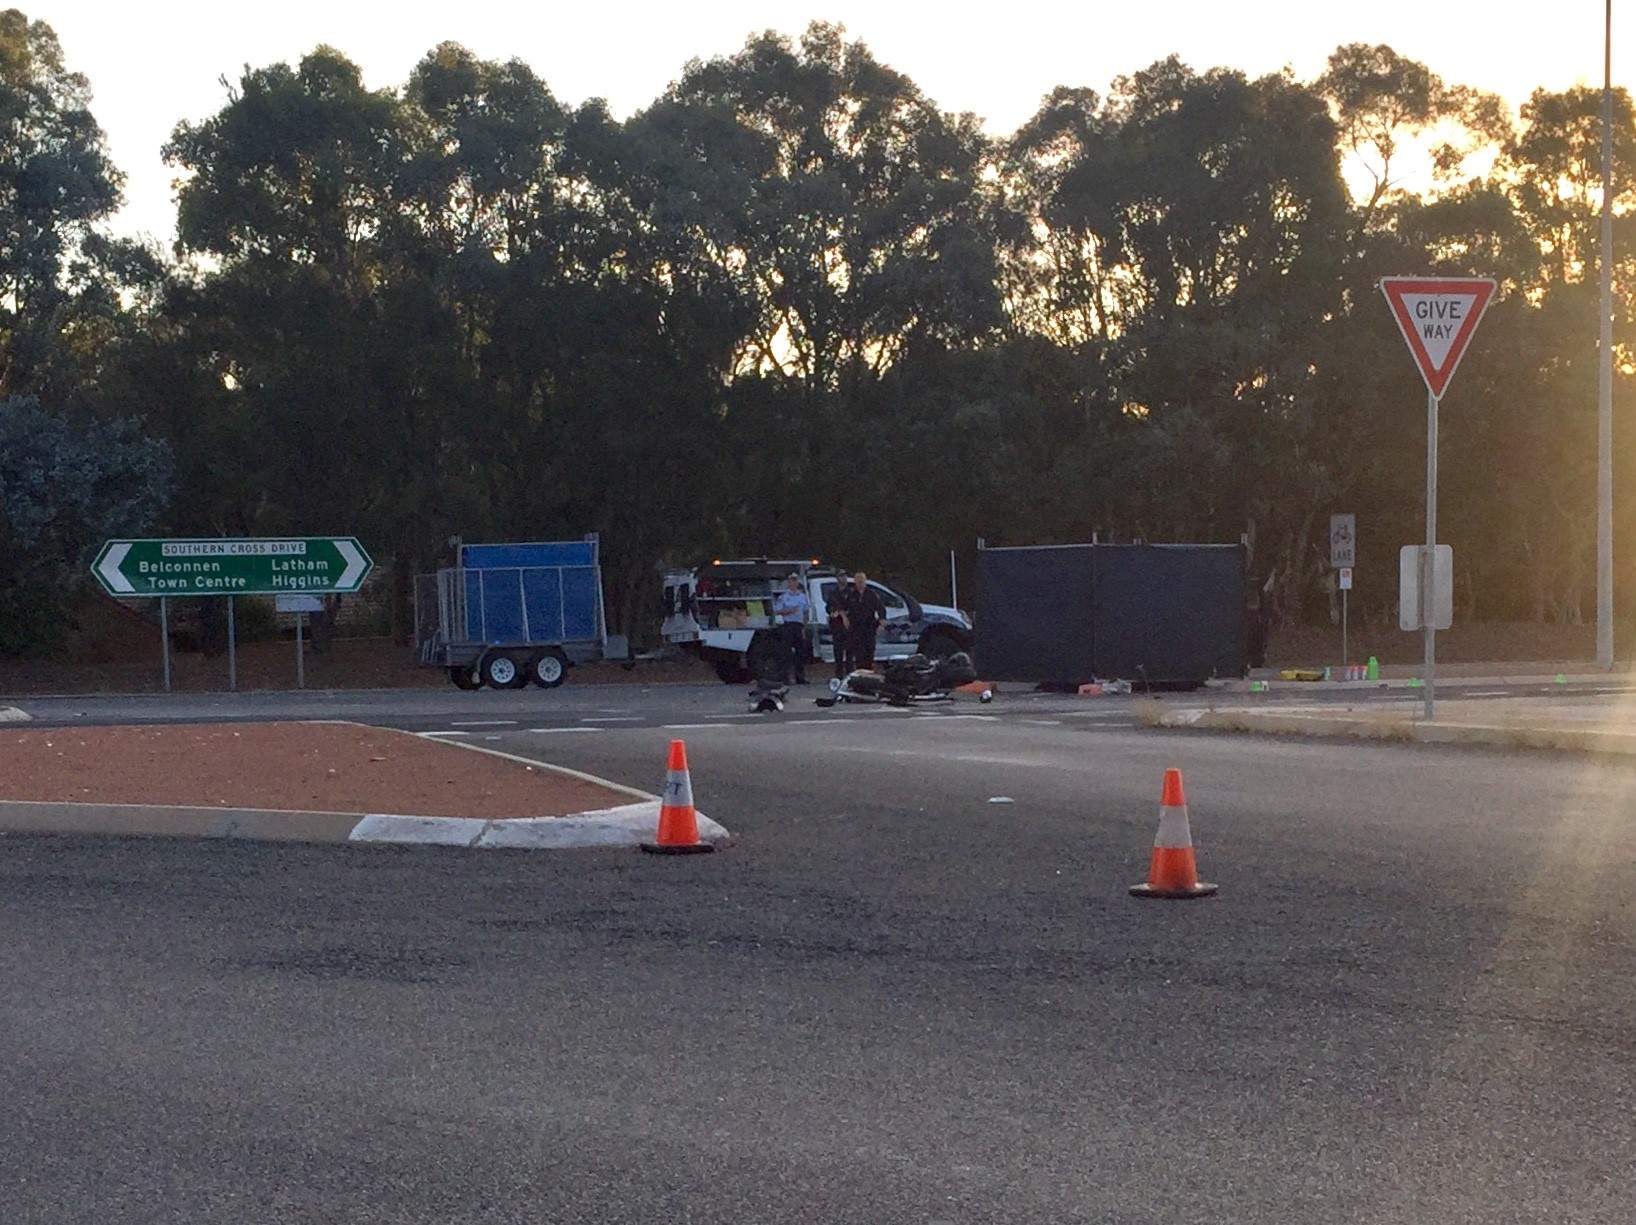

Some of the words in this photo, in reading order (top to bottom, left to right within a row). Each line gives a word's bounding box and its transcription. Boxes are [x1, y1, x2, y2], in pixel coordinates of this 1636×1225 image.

[1415, 301, 1461, 320] GIVE
[1423, 324, 1453, 339] WAY
[163, 544, 225, 555] SOUTHERN
[230, 543, 266, 554] CROSS
[271, 542, 305, 553] DRIVE
[139, 561, 221, 573] Belconnen
[271, 559, 329, 571] Latham
[148, 577, 188, 589] Town
[195, 576, 246, 588] Centre
[271, 574, 330, 588] Higgins
